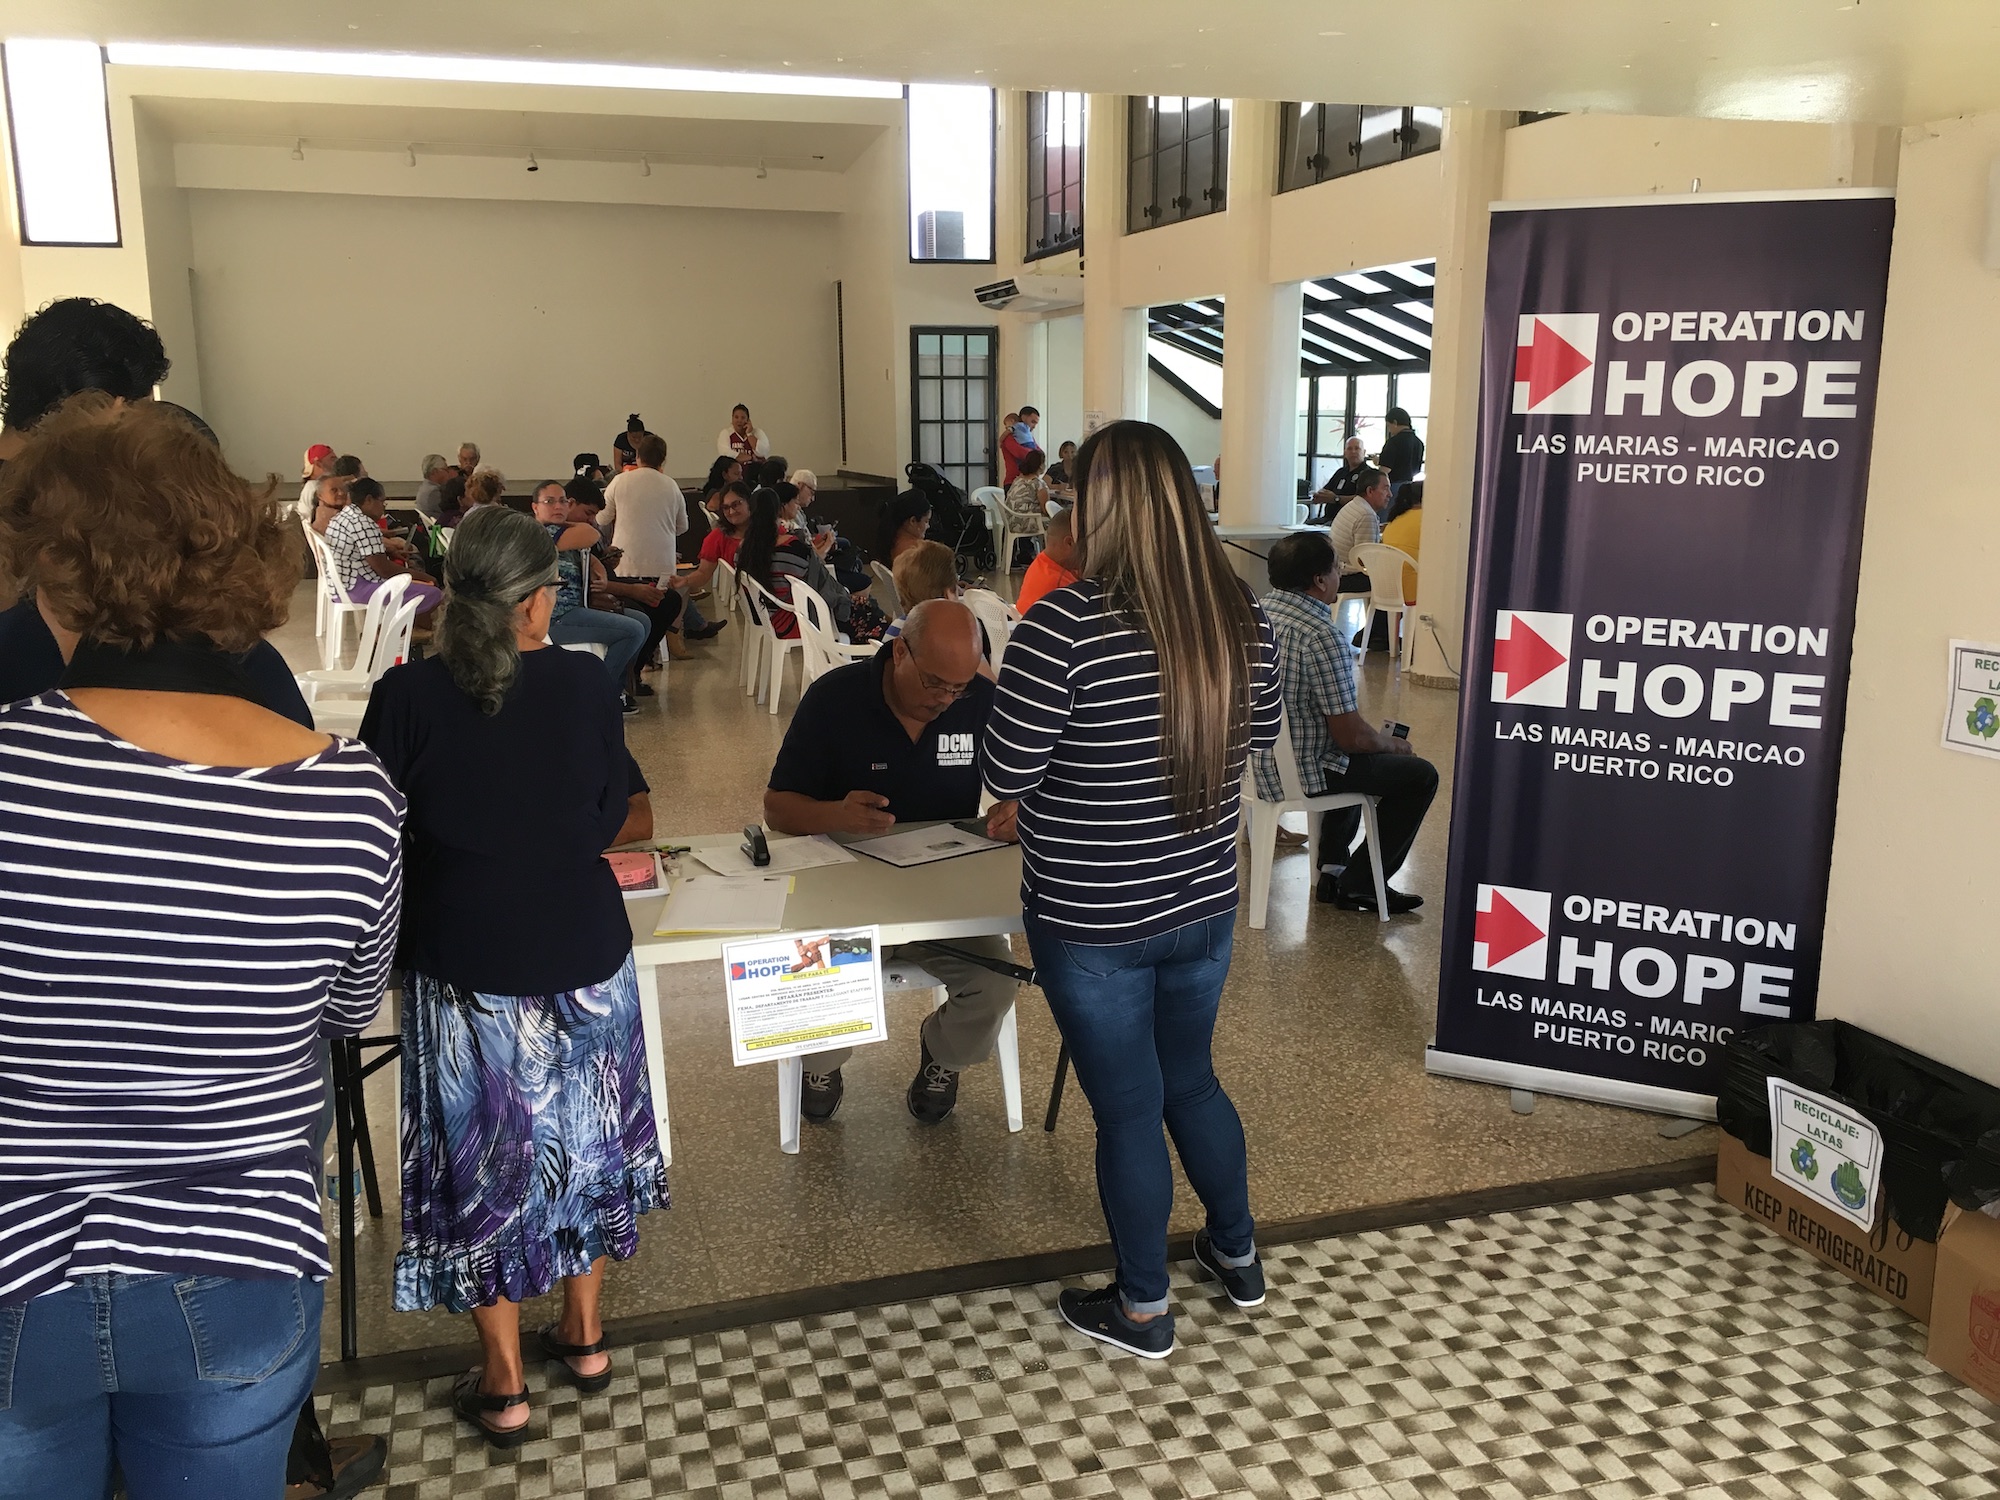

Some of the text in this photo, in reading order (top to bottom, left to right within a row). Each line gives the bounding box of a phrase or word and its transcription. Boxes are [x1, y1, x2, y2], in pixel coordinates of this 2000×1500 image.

[1612, 310, 1865, 342] OPERATION
[1605, 359, 1861, 418] HOPE
[1516, 435, 1566, 454] LAS
[1574, 436, 1679, 457] MARIAS
[1704, 437, 1839, 460] MARICAO
[1577, 464, 1765, 487] PUERTO RICO
[1585, 614, 1829, 657] OPERATION
[1579, 658, 1826, 729] HOPE
[938, 734, 974, 752] DCM
[1495, 721, 1543, 743] LAS
[1551, 725, 1651, 753] MARIAS
[1675, 737, 1806, 766] MARICAO
[1553, 752, 1734, 787] PUERTO RICO
[1563, 894, 1796, 951] OPERATION
[748, 956, 790, 966] OPERATION
[748, 964, 791, 978] HOPE
[1557, 935, 1794, 1018] HOPE
[1477, 988, 1524, 1012] LAS
[1531, 996, 1627, 1028] MARIAS
[1650, 1015, 1748, 1046] MARIC
[1534, 1021, 1707, 1067] PUERTO RICO
[1794, 1099, 1860, 1140] RECICLAJE:
[1807, 1123, 1844, 1150] LATAS
[1744, 1181, 1782, 1223] KEEP
[1788, 1206, 1908, 1301] REFRIGERATED
